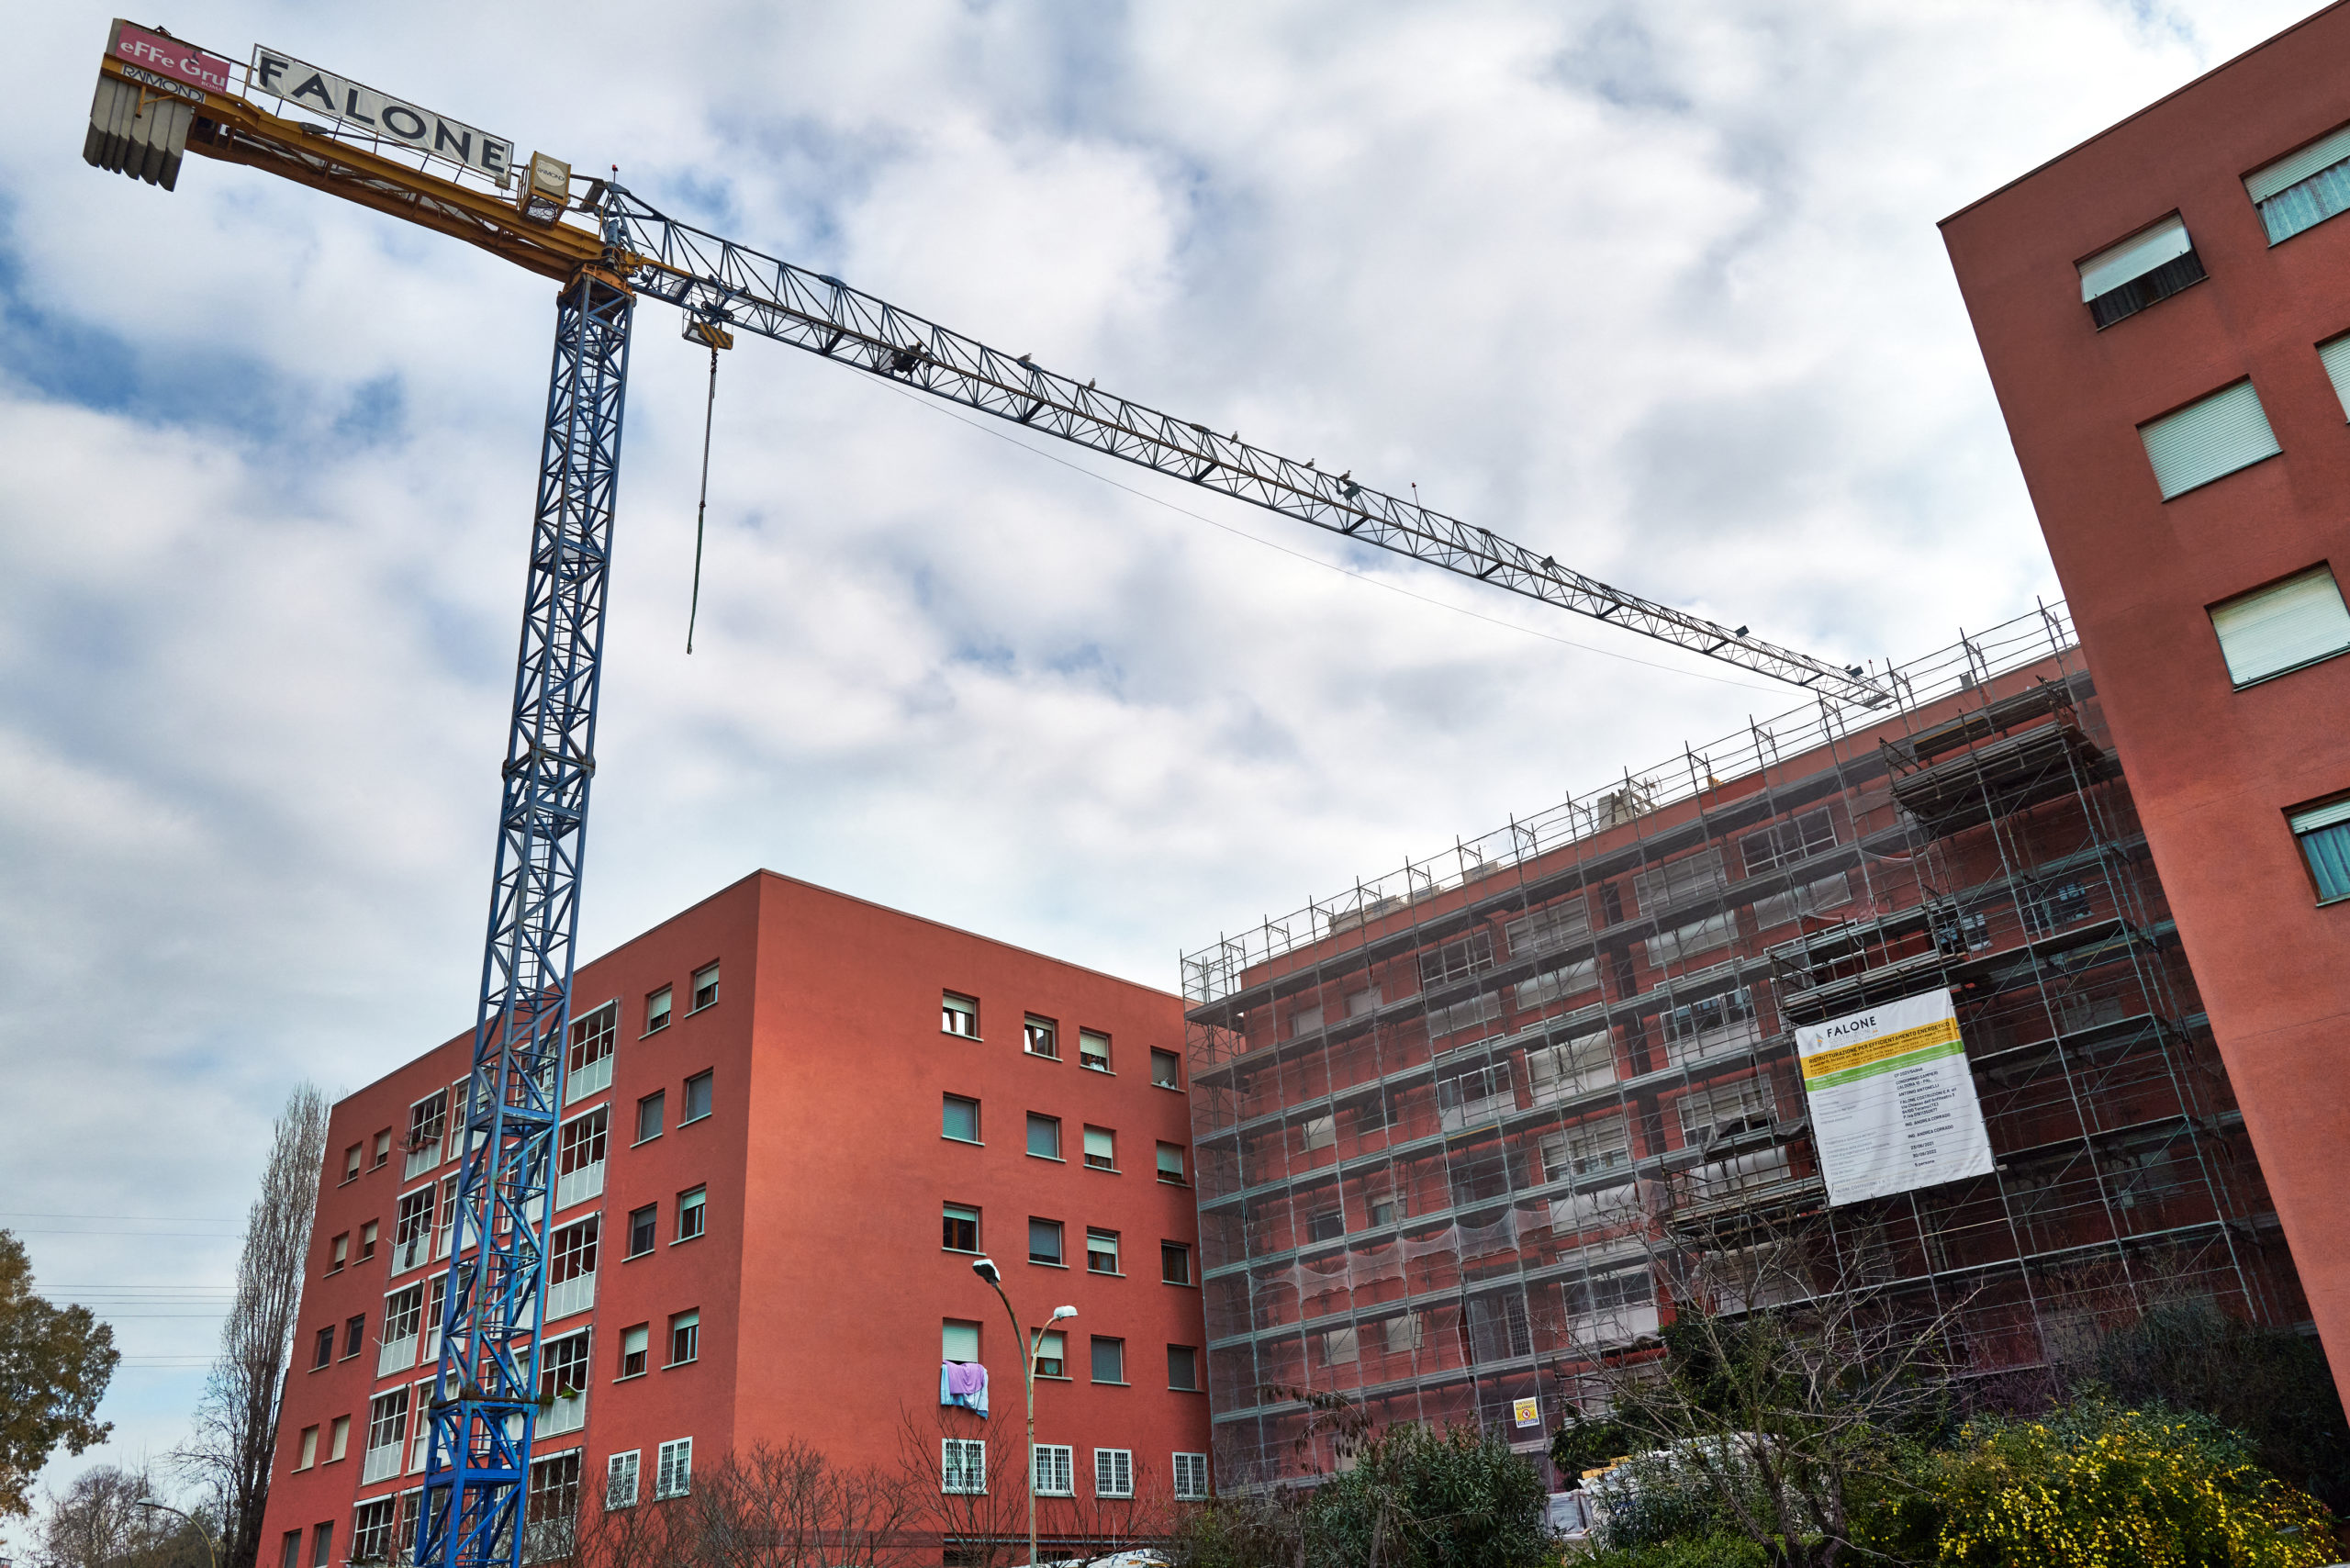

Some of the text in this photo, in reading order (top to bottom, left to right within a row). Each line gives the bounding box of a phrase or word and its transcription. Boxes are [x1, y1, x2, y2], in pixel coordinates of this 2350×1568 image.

[123, 64, 206, 103] RAIMONDI
[180, 58, 226, 87] Gru
[201, 81, 223, 93] ROMA
[260, 56, 505, 173] FALONE
[1809, 1047, 1857, 1064] RISTRUTTURAZIONE
[1869, 1031, 1917, 1047] EFFICIENTAMENTO
[1917, 1022, 1950, 1036] ENERGETICO
[1827, 1016, 1876, 1037] FALONE
